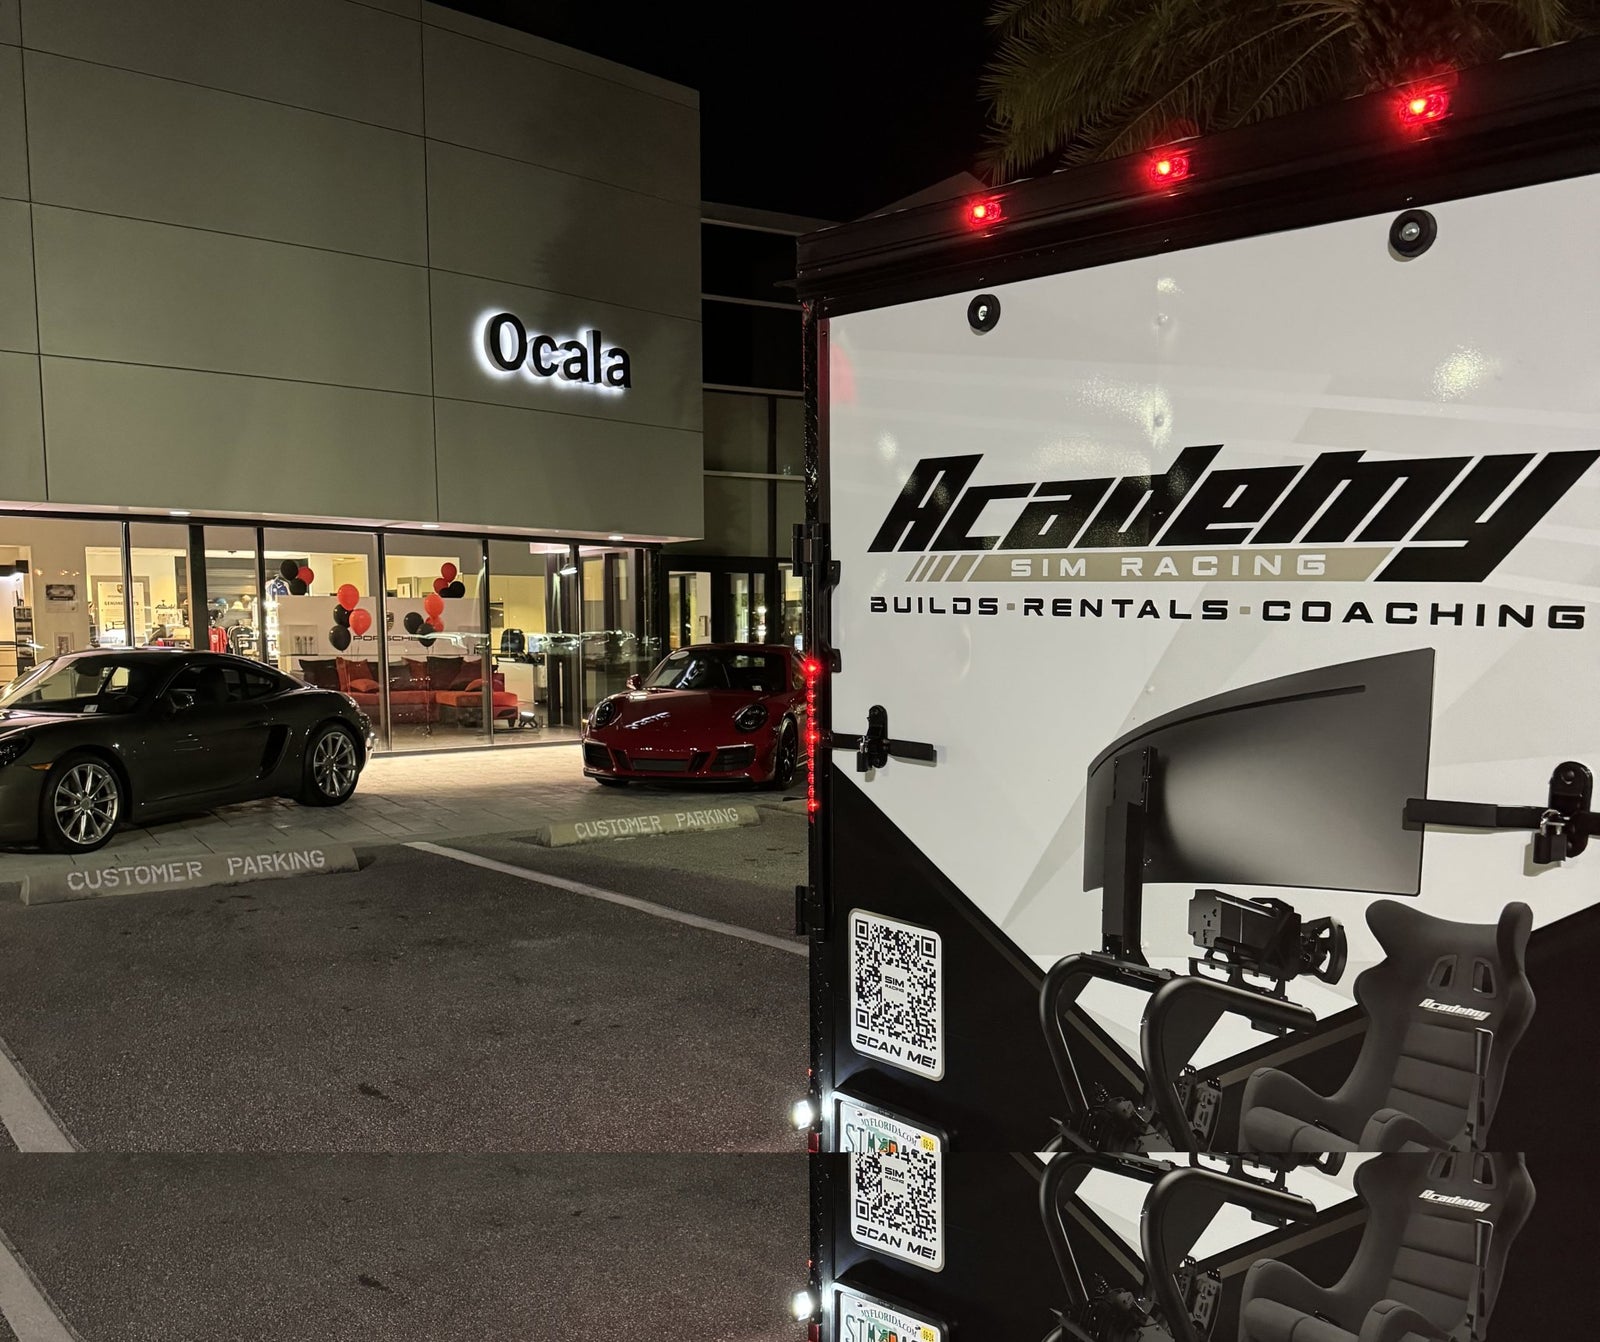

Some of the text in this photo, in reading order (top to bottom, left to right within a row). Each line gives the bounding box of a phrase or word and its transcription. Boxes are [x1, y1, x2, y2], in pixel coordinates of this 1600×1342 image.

[484, 312, 632, 389] Ocala
[867, 444, 1600, 582] Academy
[1010, 553, 1327, 578] SIM RACING
[870, 596, 1586, 630] BUILDS RENTALS COACHING
[573, 807, 739, 839] CUSTOMER PARKING
[67, 850, 326, 891] CUSTOMER PARKING
[884, 975, 905, 988] SIM
[855, 1033, 937, 1069] SCAN ME!
[884, 1166, 905, 1179] SIM
[855, 1224, 937, 1260] SCAN ME!
